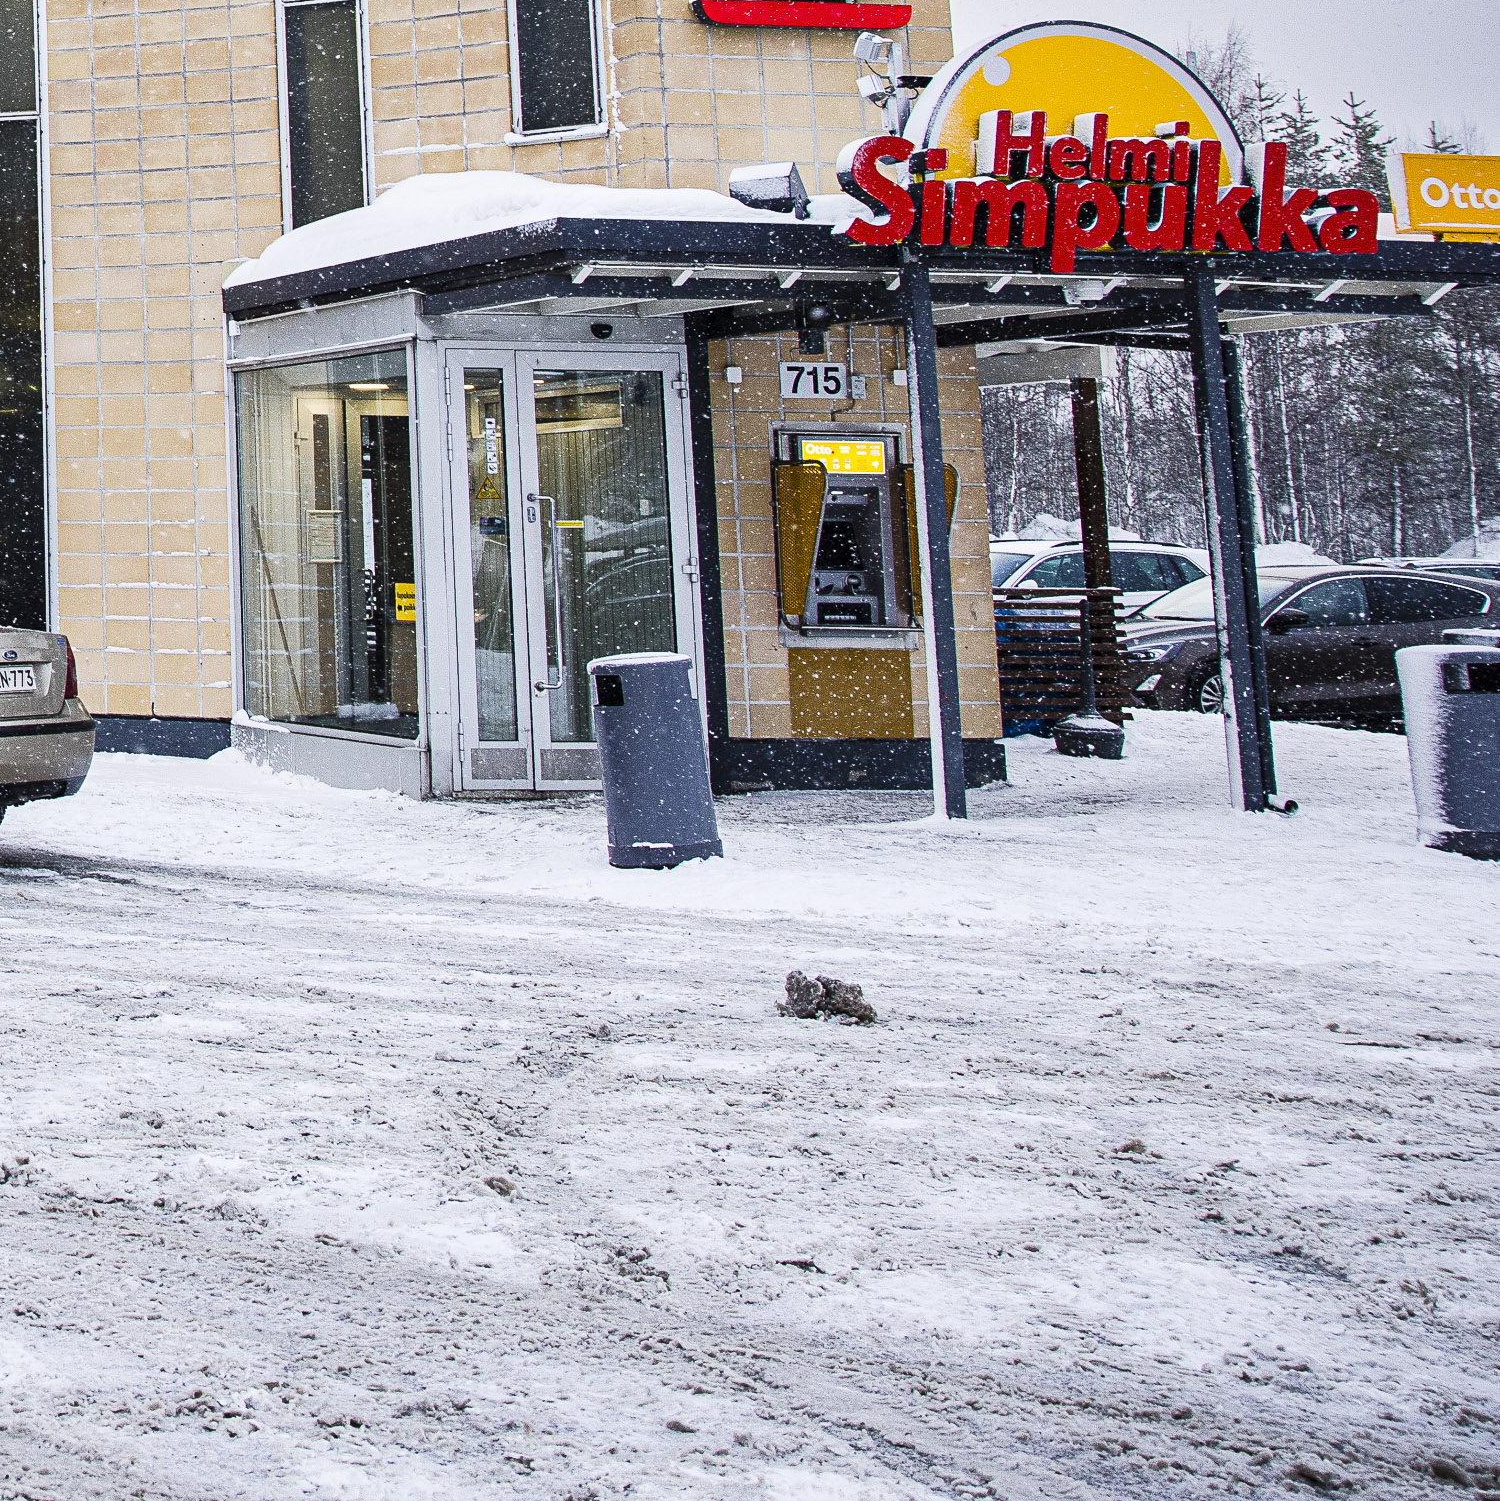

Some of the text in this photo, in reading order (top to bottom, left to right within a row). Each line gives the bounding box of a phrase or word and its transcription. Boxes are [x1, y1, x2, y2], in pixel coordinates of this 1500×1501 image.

[992, 108, 1191, 183] Helmi
[842, 135, 1379, 274] Simpukka
[786, 366, 842, 395] 715
